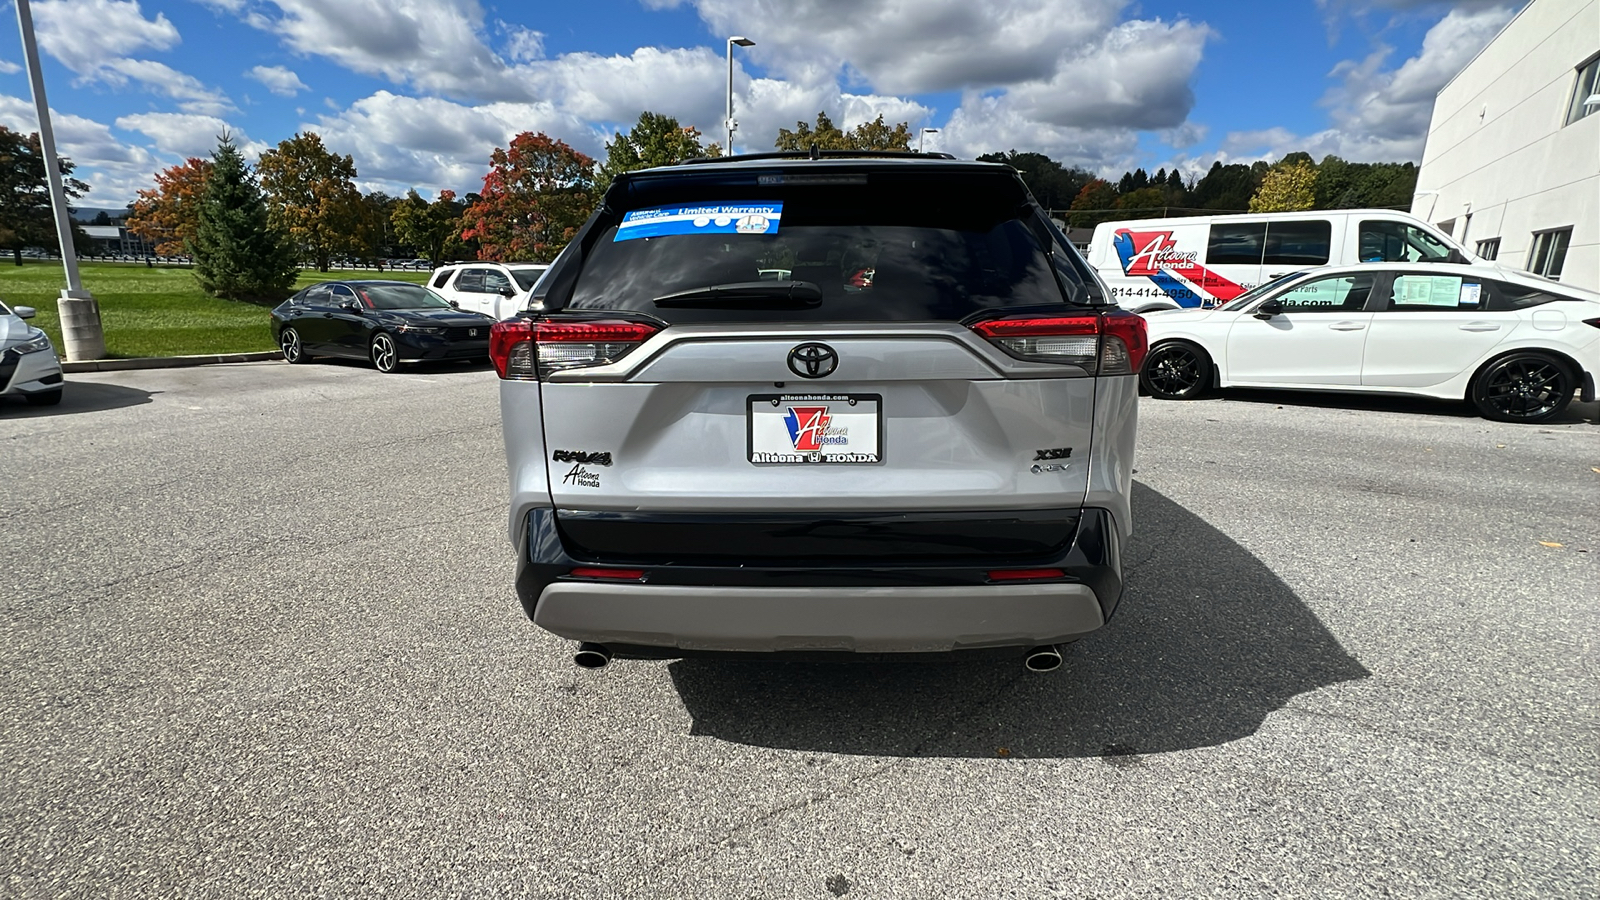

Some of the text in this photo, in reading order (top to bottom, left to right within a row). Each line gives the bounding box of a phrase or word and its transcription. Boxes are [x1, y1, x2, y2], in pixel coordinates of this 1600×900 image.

[678, 206, 774, 216] Limited Warranty
[1126, 235, 1198, 270] Altoona
[1154, 261, 1195, 269] Honda
[1111, 287, 1194, 299] 814-414-4950
[1300, 285, 1318, 293] Parts
[816, 434, 848, 445] Honda
[552, 450, 612, 465] RAV4
[752, 453, 878, 463] Altoona HONDA
[1032, 447, 1073, 461] XSE
[577, 479, 600, 488] Honda
